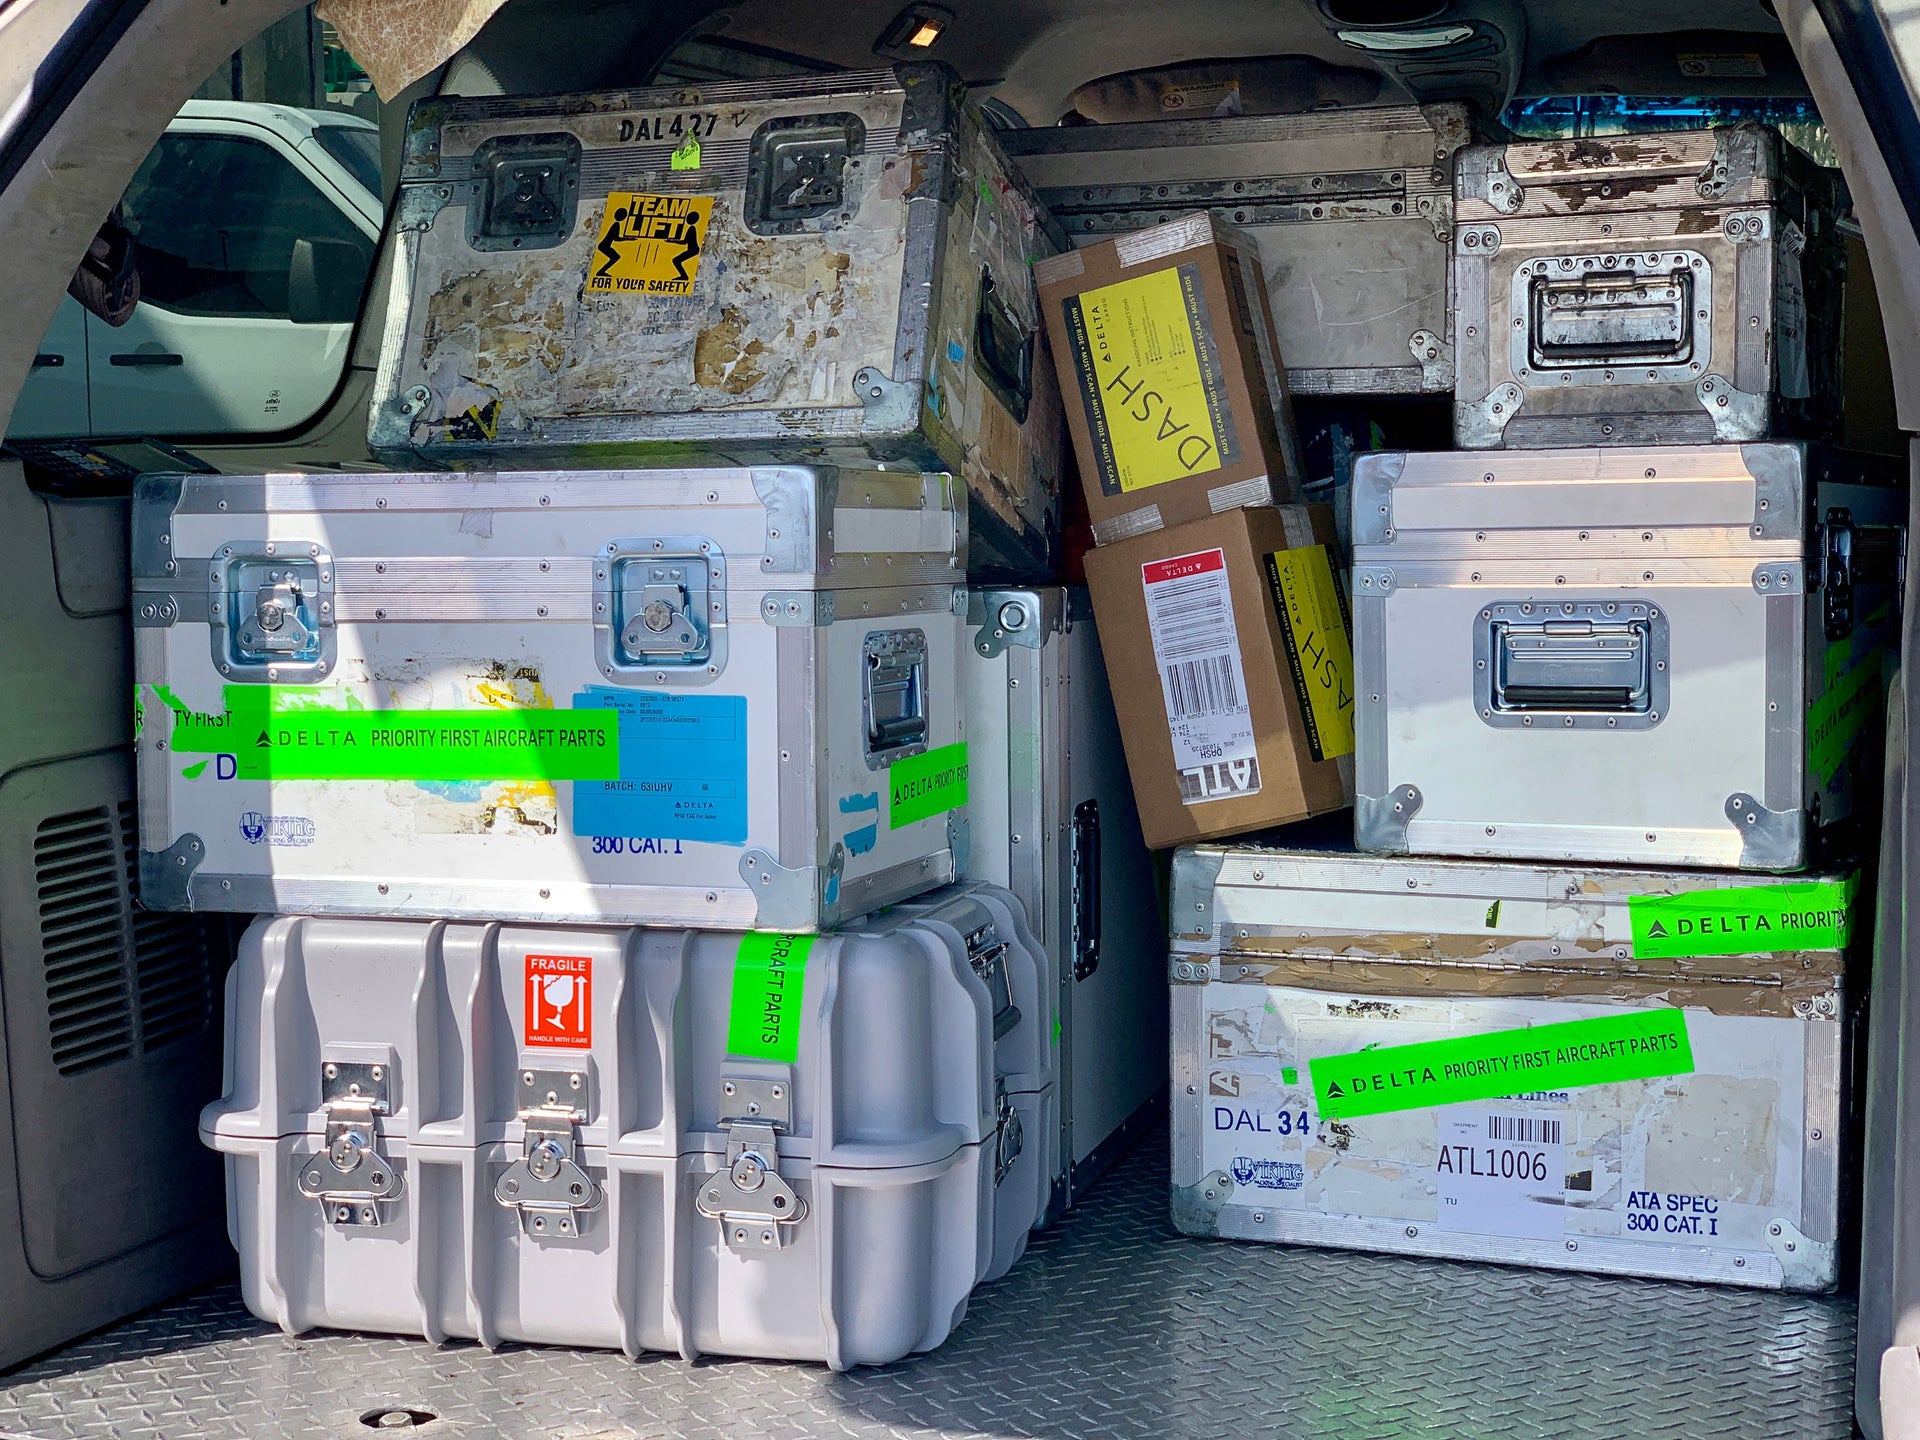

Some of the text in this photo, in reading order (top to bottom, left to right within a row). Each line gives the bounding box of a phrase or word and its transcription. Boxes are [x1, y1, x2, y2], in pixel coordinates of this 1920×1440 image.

[632, 196, 690, 218] TEAM
[624, 215, 685, 238] LIFT
[591, 277, 612, 289] FOR
[616, 278, 645, 290] YOUR
[648, 280, 690, 293] SAFETY
[1100, 297, 1111, 323] CARGO
[1091, 304, 1108, 351] DELTA
[1184, 275, 1230, 454] MUST SCAN MUST RIDE MUST SCAN MUST RIDE
[1071, 306, 1116, 485] MUST RIDE MUST SCAN MUST RIDE MUST SCAN
[1106, 365, 1212, 471] DASH
[1166, 565, 1194, 576] DELTA
[1284, 566, 1298, 612] DELTA
[1270, 563, 1319, 750] MUST RIDE MUST SCAN MUST RIDE MUST SCAN
[279, 729, 606, 748] DELTA PRIORITY FIRST AIRCRAFT PARTS
[1200, 748, 1222, 758] DASH
[604, 781, 637, 791] BATCH:
[904, 776, 932, 800] DELTA
[934, 768, 956, 790] PRIORITY
[1183, 760, 1252, 796] ATL
[592, 836, 624, 854] 300
[1677, 914, 1772, 935] DELTA
[530, 958, 586, 972] FRAGILE
[762, 992, 782, 1044] PARTS
[1351, 1032, 1679, 1094] DELTA PRIORITY FIRST AIRCRAFT PARTS
[1214, 1107, 1310, 1135] DAL 34
[1438, 1145, 1547, 1181] ATL1006
[1444, 1198, 1458, 1206] TU
[1627, 1190, 1718, 1214] ATA SPEC
[1627, 1212, 1718, 1236] 300 CAT. I
